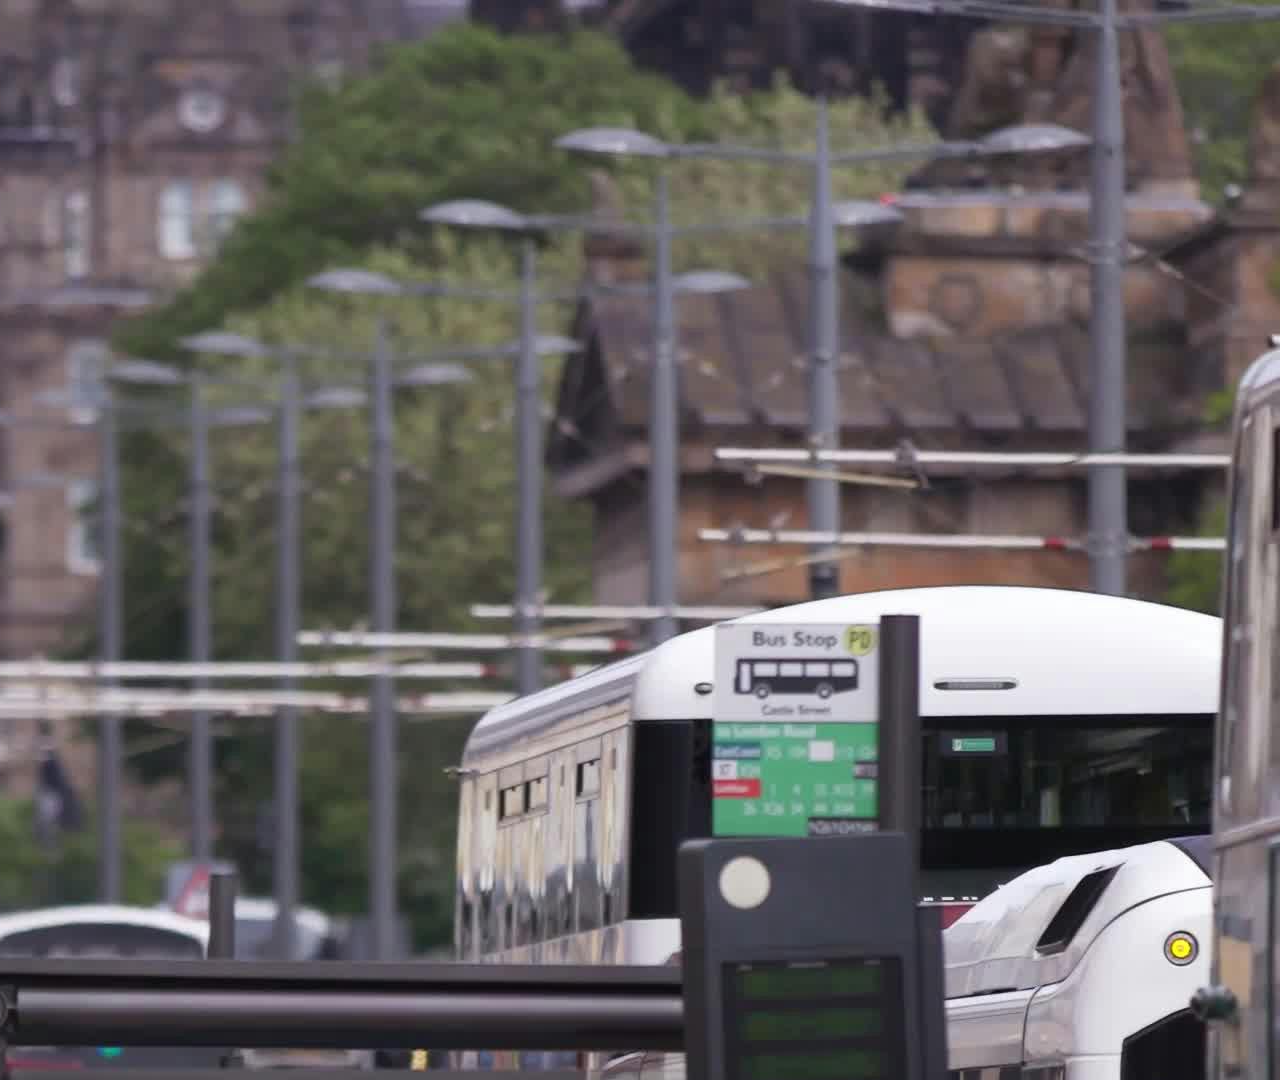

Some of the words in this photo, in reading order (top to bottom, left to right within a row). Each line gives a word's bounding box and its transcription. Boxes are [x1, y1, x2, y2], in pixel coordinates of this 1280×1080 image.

[752, 631, 786, 647] Bus
[793, 630, 838, 651] Stop
[849, 630, 871, 649] PD
